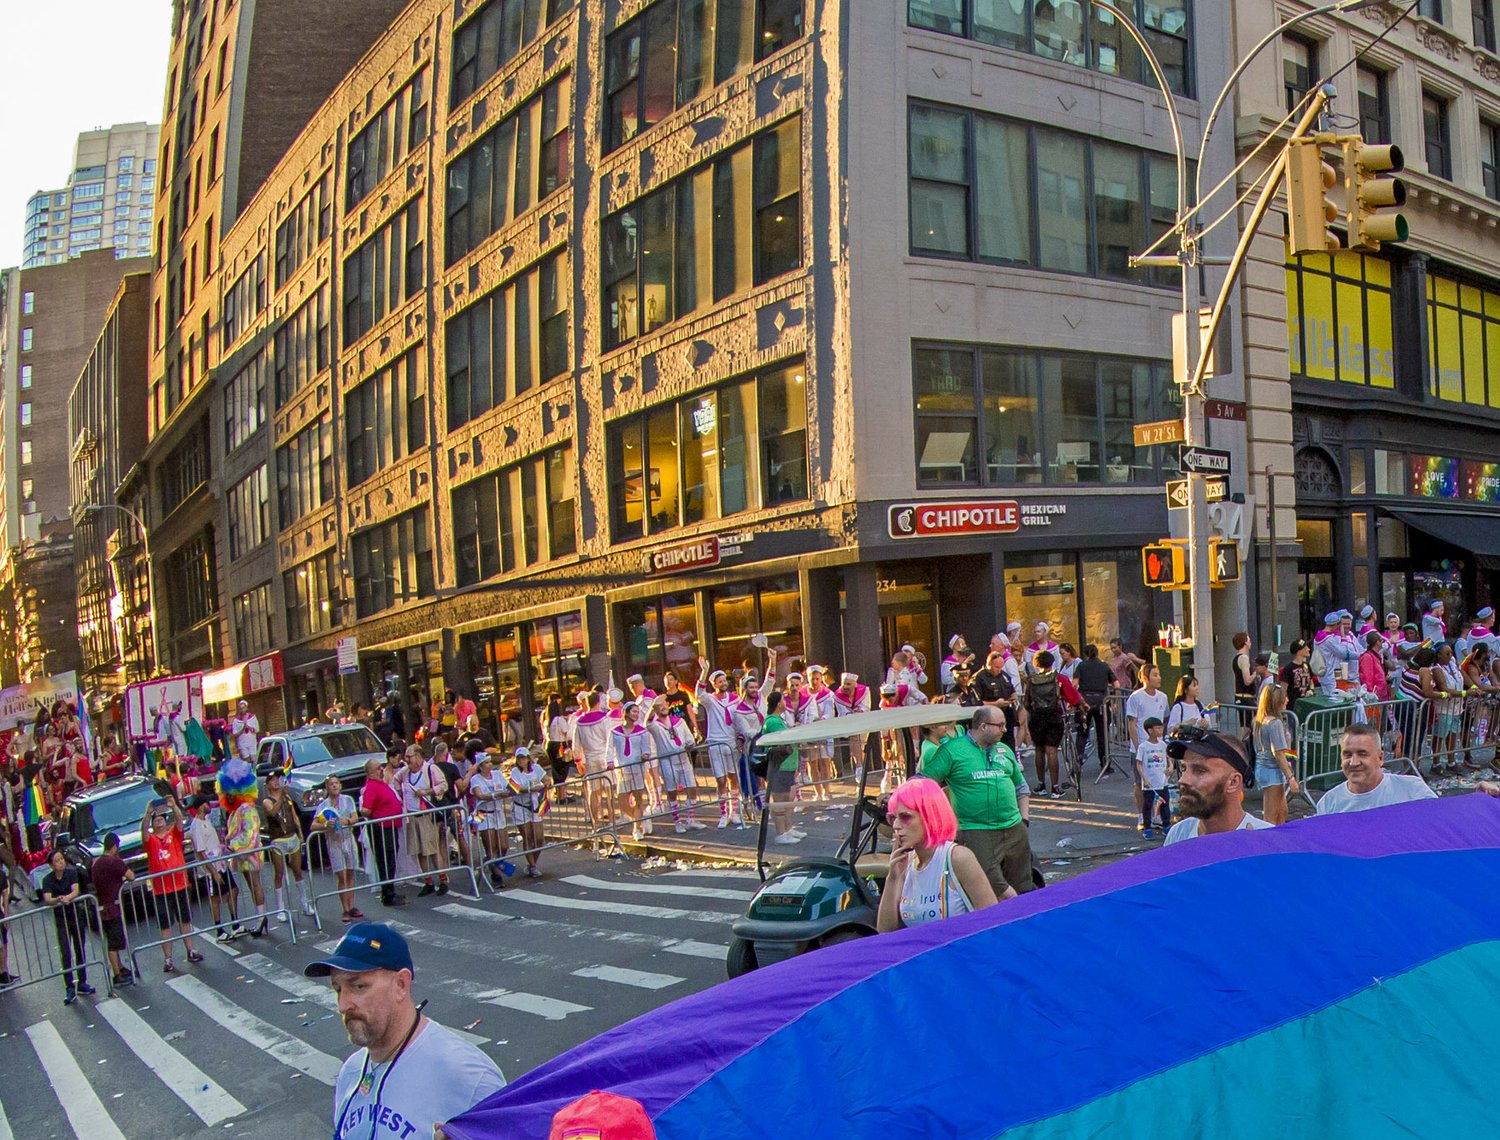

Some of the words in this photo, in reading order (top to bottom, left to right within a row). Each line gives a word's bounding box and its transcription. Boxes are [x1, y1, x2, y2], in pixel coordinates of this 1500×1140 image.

[1217, 404, 1222, 416] 5
[1224, 405, 1234, 417] Av
[1142, 429, 1151, 443] W
[1166, 427, 1176, 440] St
[1188, 455, 1202, 466] ONE
[1209, 456, 1225, 468] WAY
[1426, 471, 1445, 482] LOVE
[1481, 477, 1500, 488] PRIDE
[1177, 489, 1188, 500] ON
[1021, 504, 1067, 514] MEXICAN
[922, 508, 1017, 529] CHIPOTLE
[1021, 515, 1052, 526] GRILL
[653, 542, 713, 569] CHIPOTLE
[876, 580, 897, 592] 234
[369, 1104, 416, 1140] WEST
